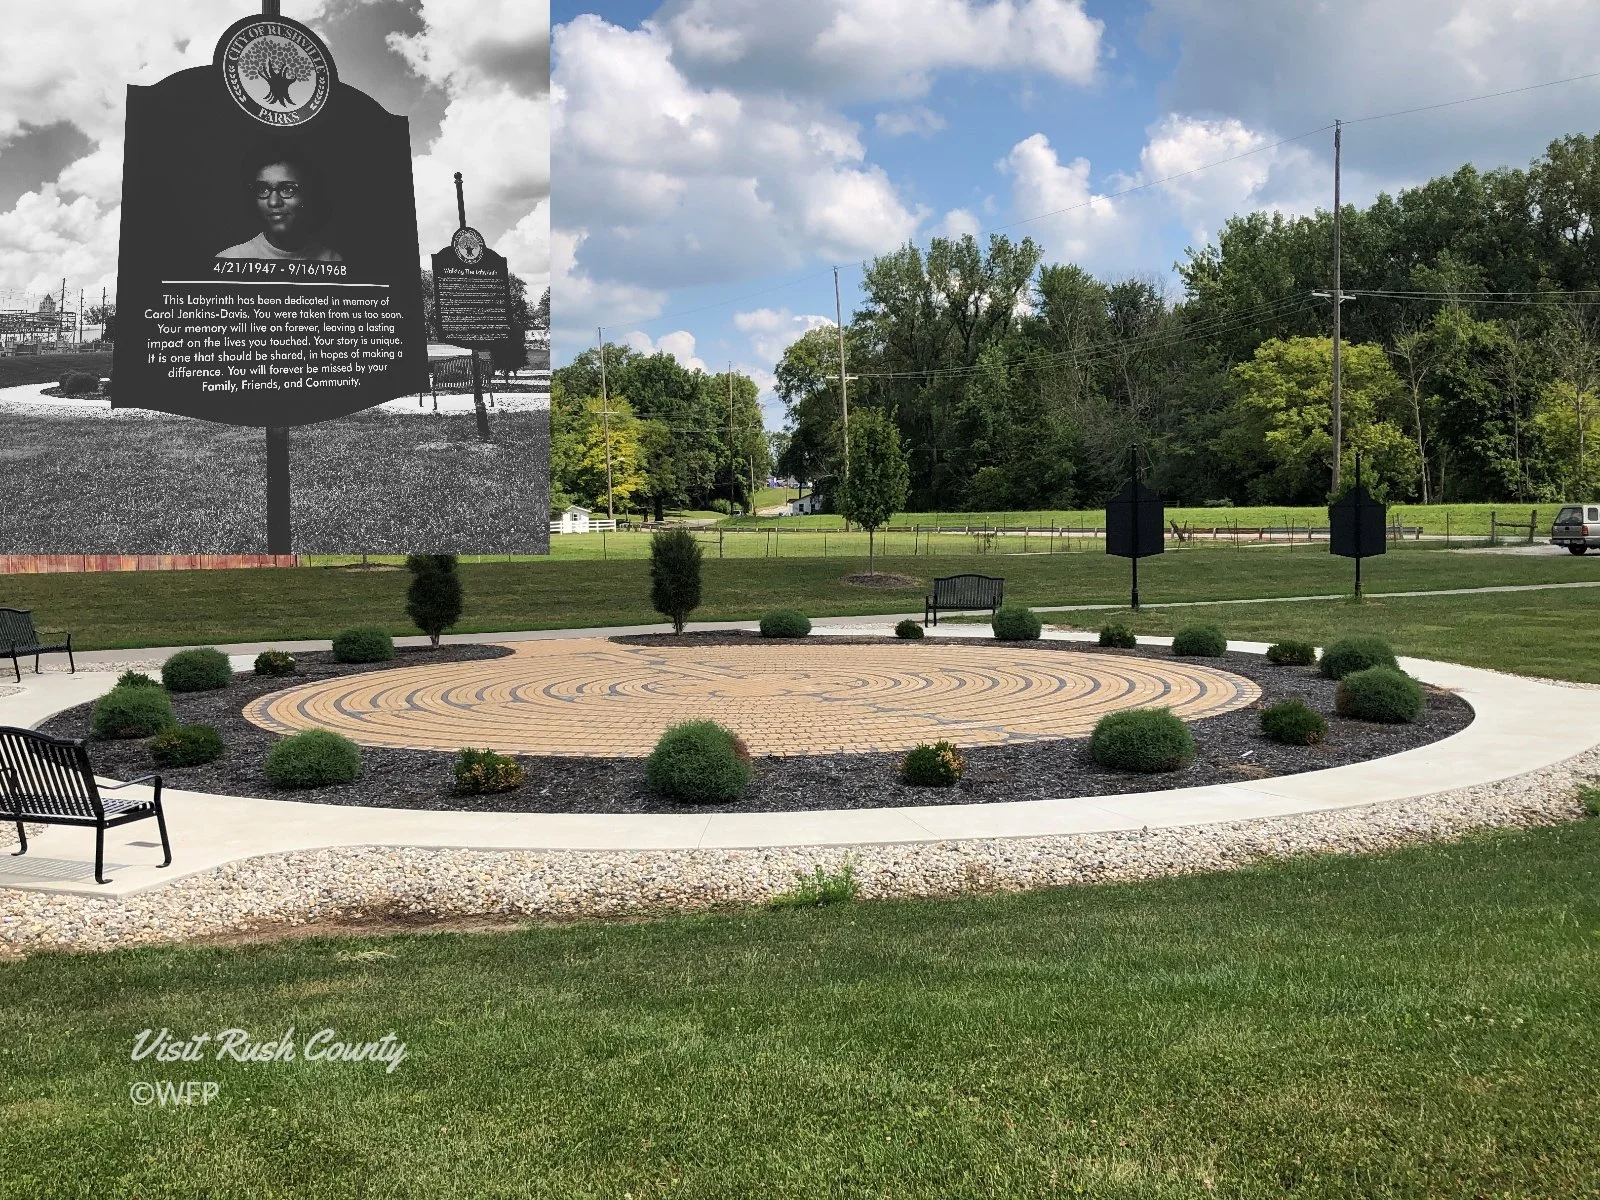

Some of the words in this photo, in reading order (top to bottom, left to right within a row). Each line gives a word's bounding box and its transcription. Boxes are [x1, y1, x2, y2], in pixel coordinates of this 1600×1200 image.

[228, 32, 249, 60] CITY
[248, 25, 265, 38] OF
[268, 24, 326, 74] RUSHVILLE
[257, 107, 300, 124] PARKS
[213, 261, 277, 274] 4/21/1947
[288, 263, 347, 276] 9/16/1968
[162, 294, 185, 305] This
[187, 294, 235, 307] Labyrinth
[237, 294, 255, 305] has
[257, 294, 282, 305] been
[284, 295, 329, 306] dedicated
[331, 296, 340, 306] in
[342, 298, 379, 308] memory
[380, 296, 390, 306] of
[144, 308, 174, 319] Carol
[176, 308, 250, 319] Jenkins-Davis.
[253, 308, 271, 319] You
[273, 311, 298, 319] were
[299, 308, 326, 319] taken
[327, 308, 350, 319] from
[364, 310, 379, 319] too
[157, 323, 182, 334] Your
[184, 325, 228, 335] memory
[229, 322, 247, 333] will
[250, 322, 267, 333] live
[269, 325, 283, 333] on
[284, 321, 320, 334] forever,
[323, 321, 356, 334] leaving
[357, 324, 364, 332] a
[366, 322, 395, 334] lasting
[147, 338, 184, 351] impact
[186, 340, 201, 348] on
[203, 336, 221, 348] the
[223, 336, 246, 347] lives
[248, 339, 267, 349] you
[269, 335, 311, 347] touched.
[313, 335, 335, 346] Your
[336, 336, 359, 348] story
[360, 335, 368, 345] is
[370, 335, 403, 347] unique.
[147, 353, 156, 364] It
[158, 352, 167, 364] is
[170, 355, 191, 363] one
[193, 351, 215, 362] that
[217, 350, 252, 362] should
[255, 350, 268, 361] be
[270, 349, 306, 361] shared,
[309, 349, 318, 360] in
[320, 348, 349, 362] hopes
[350, 348, 360, 359] of
[362, 348, 395, 360] making
[397, 350, 403, 358] a
[167, 366, 224, 378] difference.
[227, 365, 247, 376] You
[249, 364, 267, 375] will
[268, 363, 304, 375] forever
[306, 363, 319, 374] be
[321, 362, 353, 373] missed
[355, 361, 366, 374] by
[367, 364, 388, 374] your
[202, 379, 239, 394] Family,
[241, 378, 281, 391] Friends,
[283, 377, 303, 389] and
[305, 376, 361, 388] Community.
